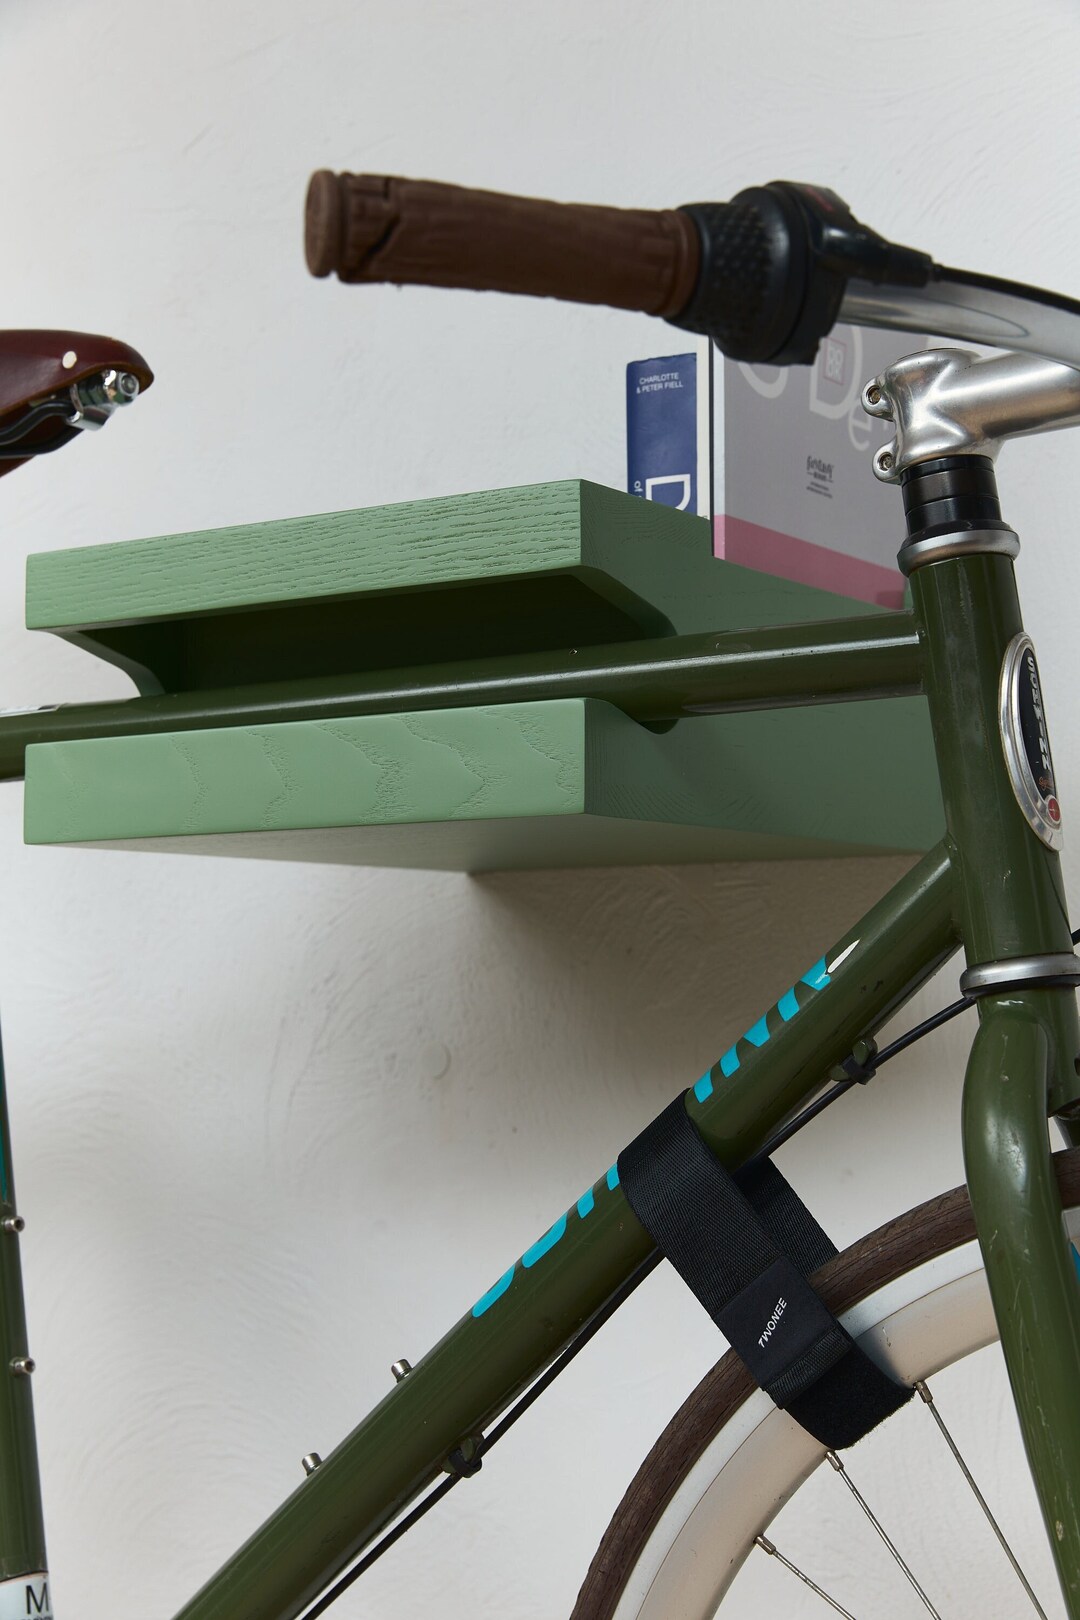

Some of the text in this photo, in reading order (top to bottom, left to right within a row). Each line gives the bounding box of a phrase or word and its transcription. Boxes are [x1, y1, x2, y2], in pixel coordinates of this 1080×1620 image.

[636, 380, 684, 394] & PETER FIELL
[639, 372, 679, 384] CHARLOTTE
[758, 1297, 787, 1348] TWONEE
[26, 1582, 49, 1615] M
